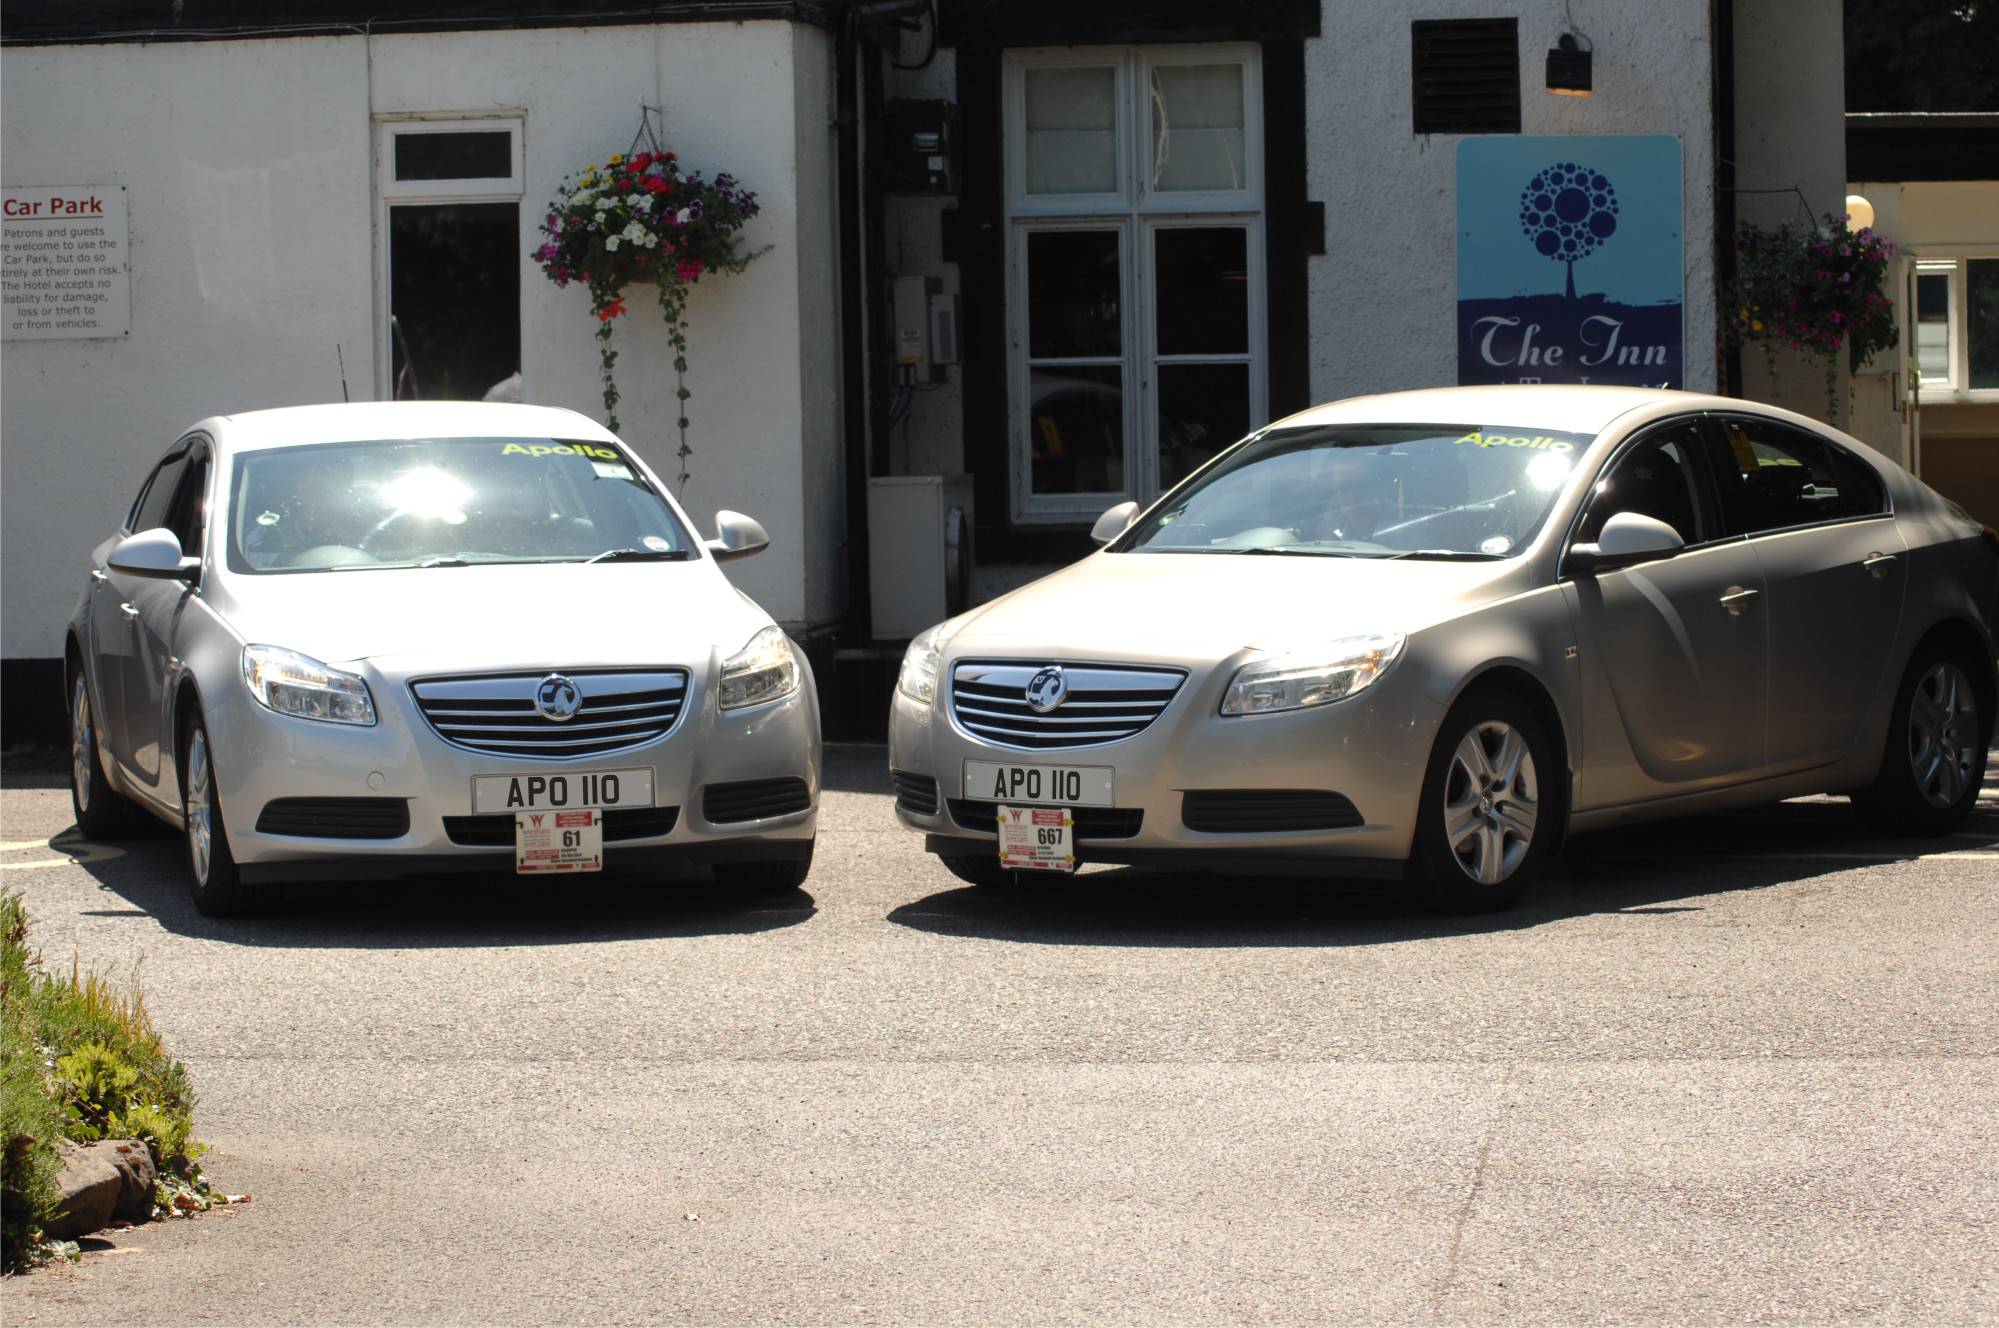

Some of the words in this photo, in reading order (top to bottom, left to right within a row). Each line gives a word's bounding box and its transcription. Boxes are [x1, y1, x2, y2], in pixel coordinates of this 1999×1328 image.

[3, 198, 42, 216] Car
[50, 196, 103, 215] Park
[4, 228, 44, 239] Patrons
[46, 227, 66, 238] and
[70, 227, 105, 240] guests
[13, 240, 59, 251] welcome
[63, 240, 74, 250] to
[77, 241, 96, 250] use
[98, 238, 117, 249] the
[4, 254, 23, 265] Car
[26, 254, 53, 265] Park,
[56, 253, 74, 263] but
[77, 252, 91, 263] do
[94, 254, 106, 262] so
[31, 268, 42, 277] at
[46, 265, 70, 277] their
[74, 267, 96, 276] own
[98, 264, 122, 275] risk.
[1, 281, 20, 291] The
[23, 279, 51, 290] Hotel
[54, 279, 94, 292] accepts
[97, 280, 111, 288] no
[3, 293, 41, 305] liability
[44, 293, 59, 303] for
[62, 291, 109, 304] damage,
[17, 306, 38, 317] loss
[42, 307, 52, 316] or
[56, 304, 81, 315] theft
[84, 305, 95, 315] to
[12, 321, 24, 330] or
[27, 319, 51, 329] from
[1470, 315, 1563, 367] The
[1578, 315, 1668, 367] Inn
[1454, 431, 1574, 453] Apollo
[502, 443, 618, 459] Apollo
[506, 776, 568, 808] APO
[582, 774, 620, 805] 110
[994, 768, 1041, 799] APO
[1052, 769, 1081, 801] 110
[562, 830, 581, 847] 61
[1037, 827, 1063, 845] 667
